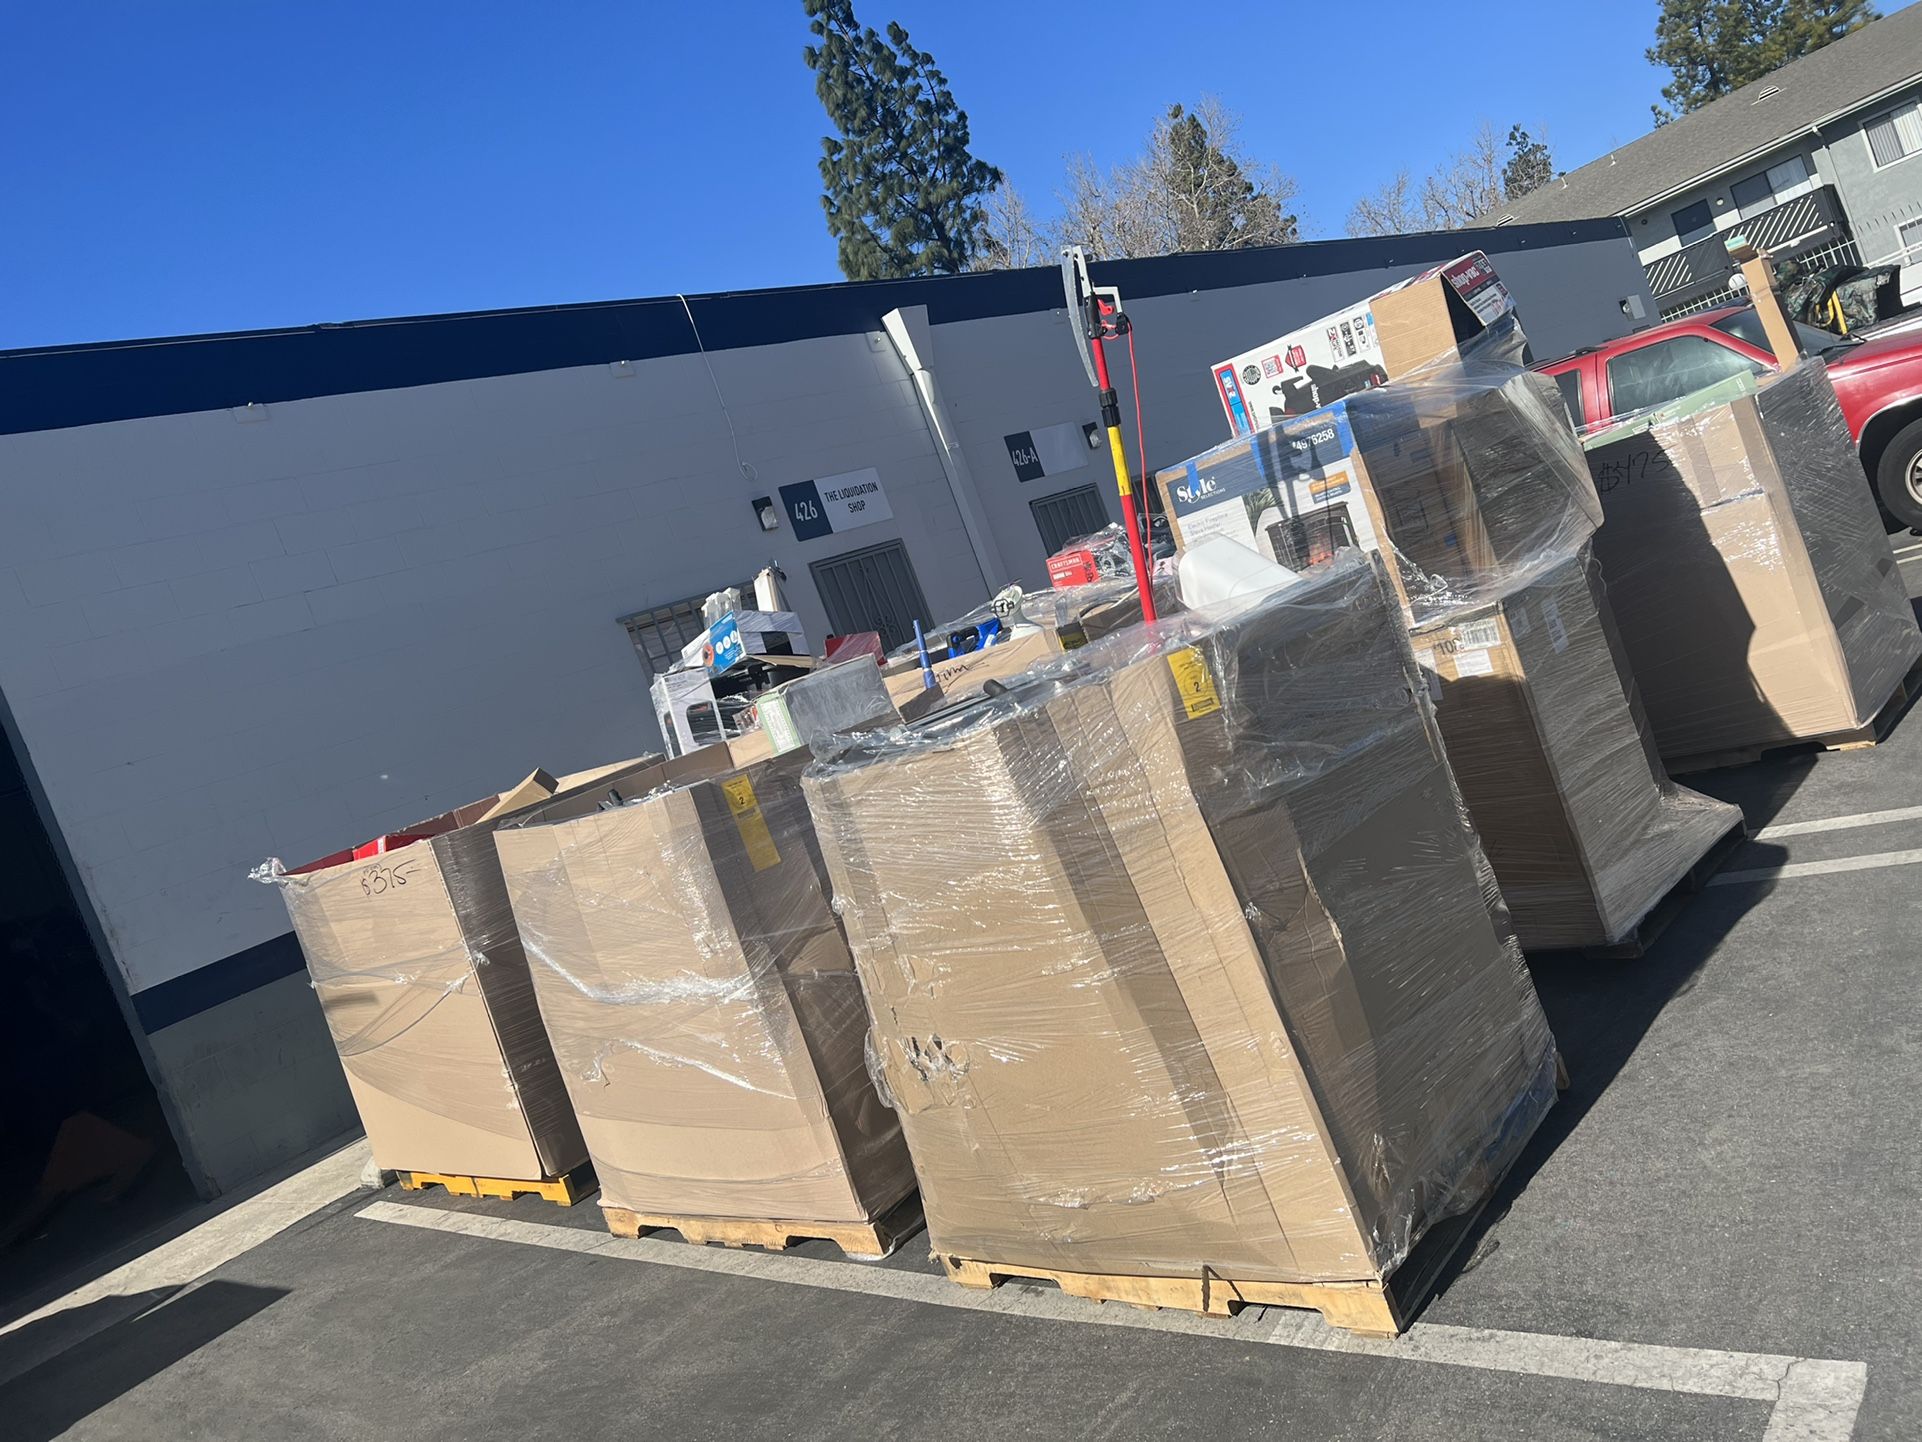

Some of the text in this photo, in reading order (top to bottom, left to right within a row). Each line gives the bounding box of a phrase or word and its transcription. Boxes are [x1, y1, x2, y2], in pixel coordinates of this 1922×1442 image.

[1012, 447, 1039, 467] 426-A
[824, 481, 879, 503] THE LIQUIDATION
[794, 499, 818, 522] 426
[847, 500, 866, 513] SHOP
[1193, 681, 1202, 693] 2
[738, 796, 746, 805] 2
